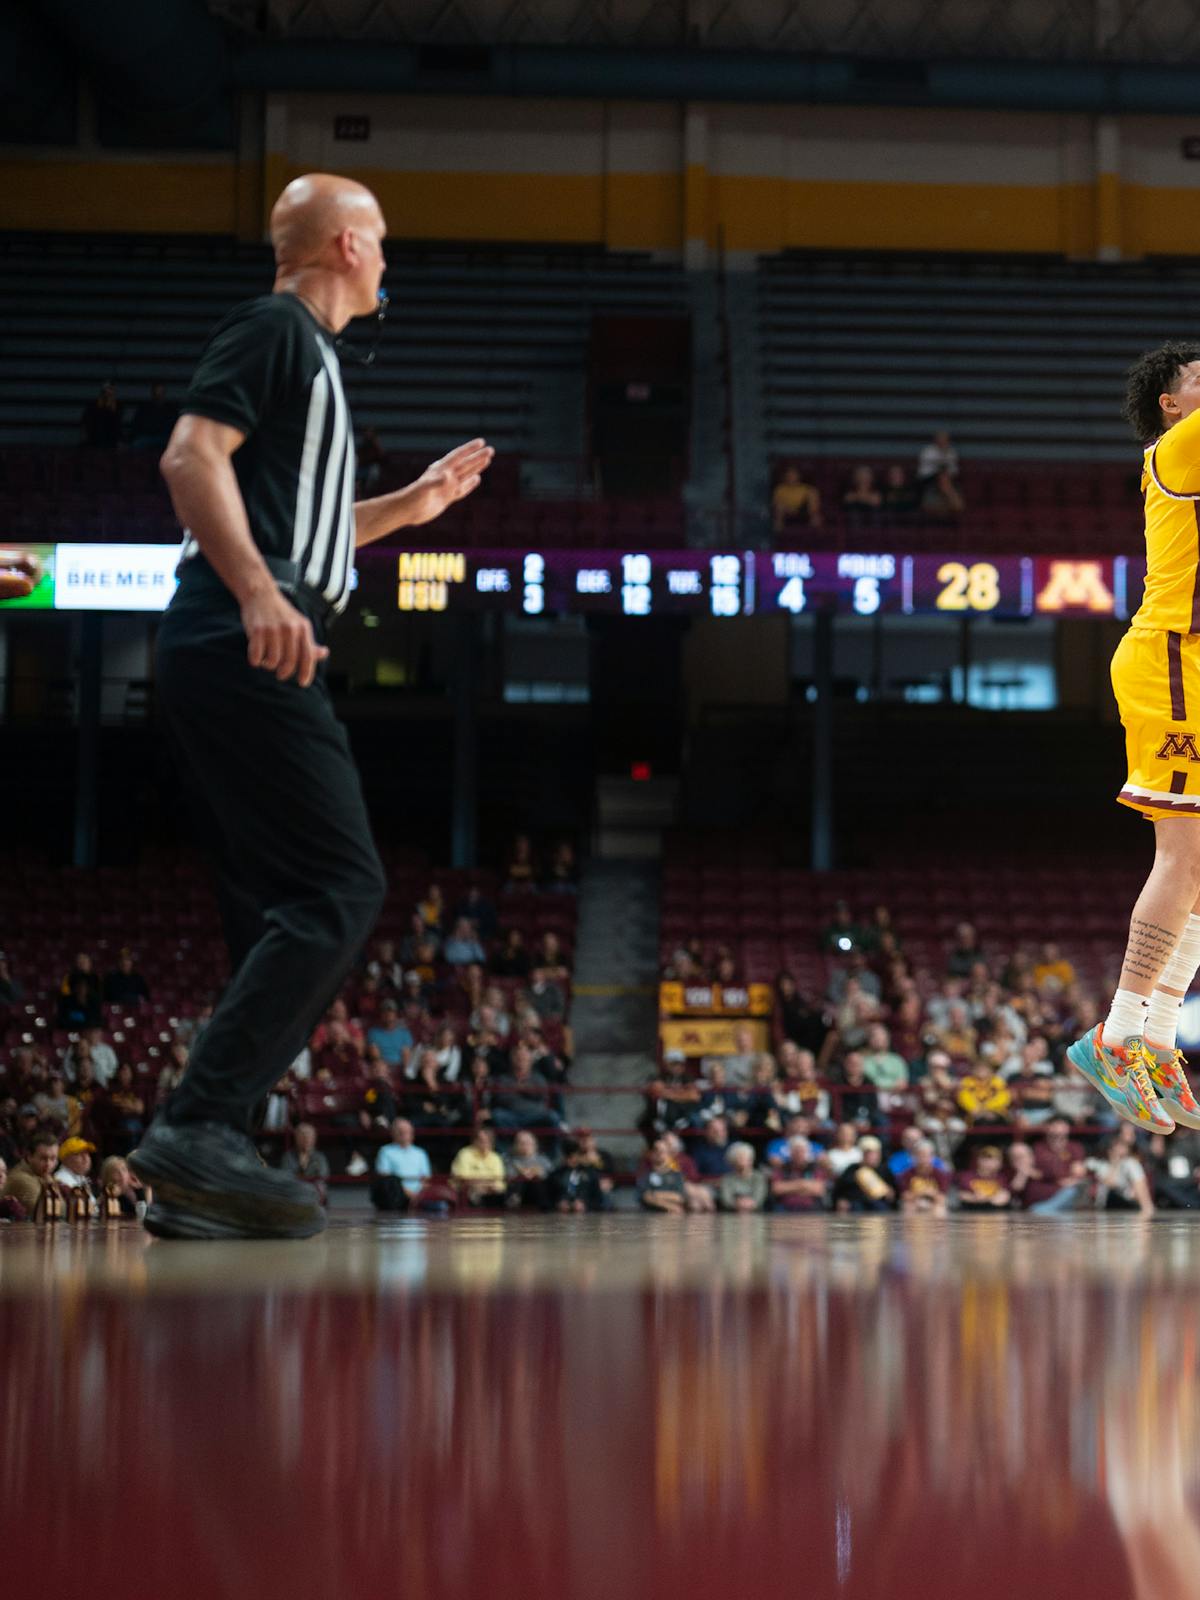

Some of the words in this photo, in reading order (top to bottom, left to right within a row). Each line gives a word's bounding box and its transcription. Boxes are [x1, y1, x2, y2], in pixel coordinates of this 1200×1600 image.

[67, 568, 166, 587] BREMER
[398, 552, 467, 583] MINN
[523, 583, 545, 614] 3
[778, 576, 807, 614] 4
[936, 562, 1001, 611] 28
